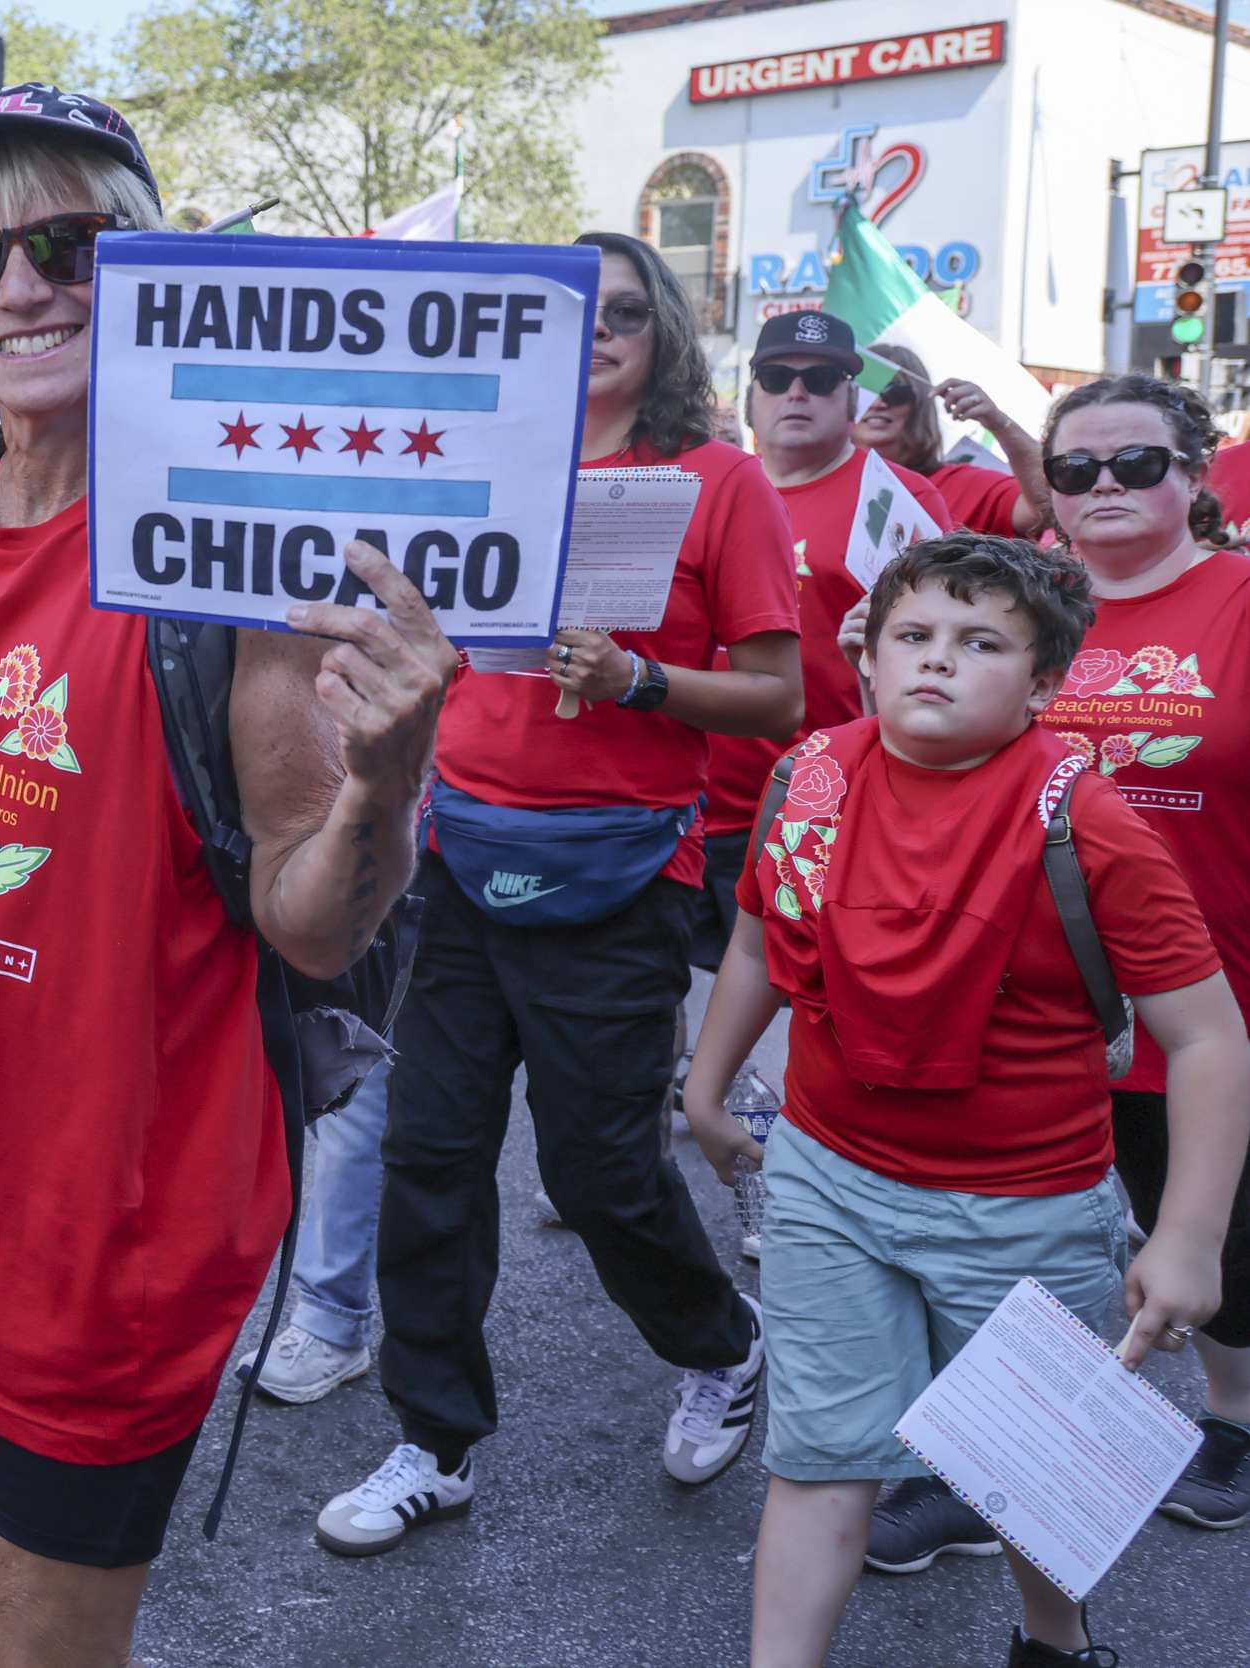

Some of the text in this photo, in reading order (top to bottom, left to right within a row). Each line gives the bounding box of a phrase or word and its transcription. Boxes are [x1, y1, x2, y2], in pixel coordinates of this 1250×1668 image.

[700, 27, 992, 97] URGENT CARE
[135, 283, 547, 359] HANDS OFF
[132, 512, 521, 611] CHICAGO
[1045, 714, 1070, 724] tuya,
[1073, 714, 1096, 725] mía,
[1099, 717, 1106, 725] y
[1107, 714, 1121, 724] de
[1123, 716, 1173, 727] nosotros
[1139, 698, 1203, 718] Union
[1047, 757, 1086, 811] TEACH
[491, 870, 542, 896] NIKE
